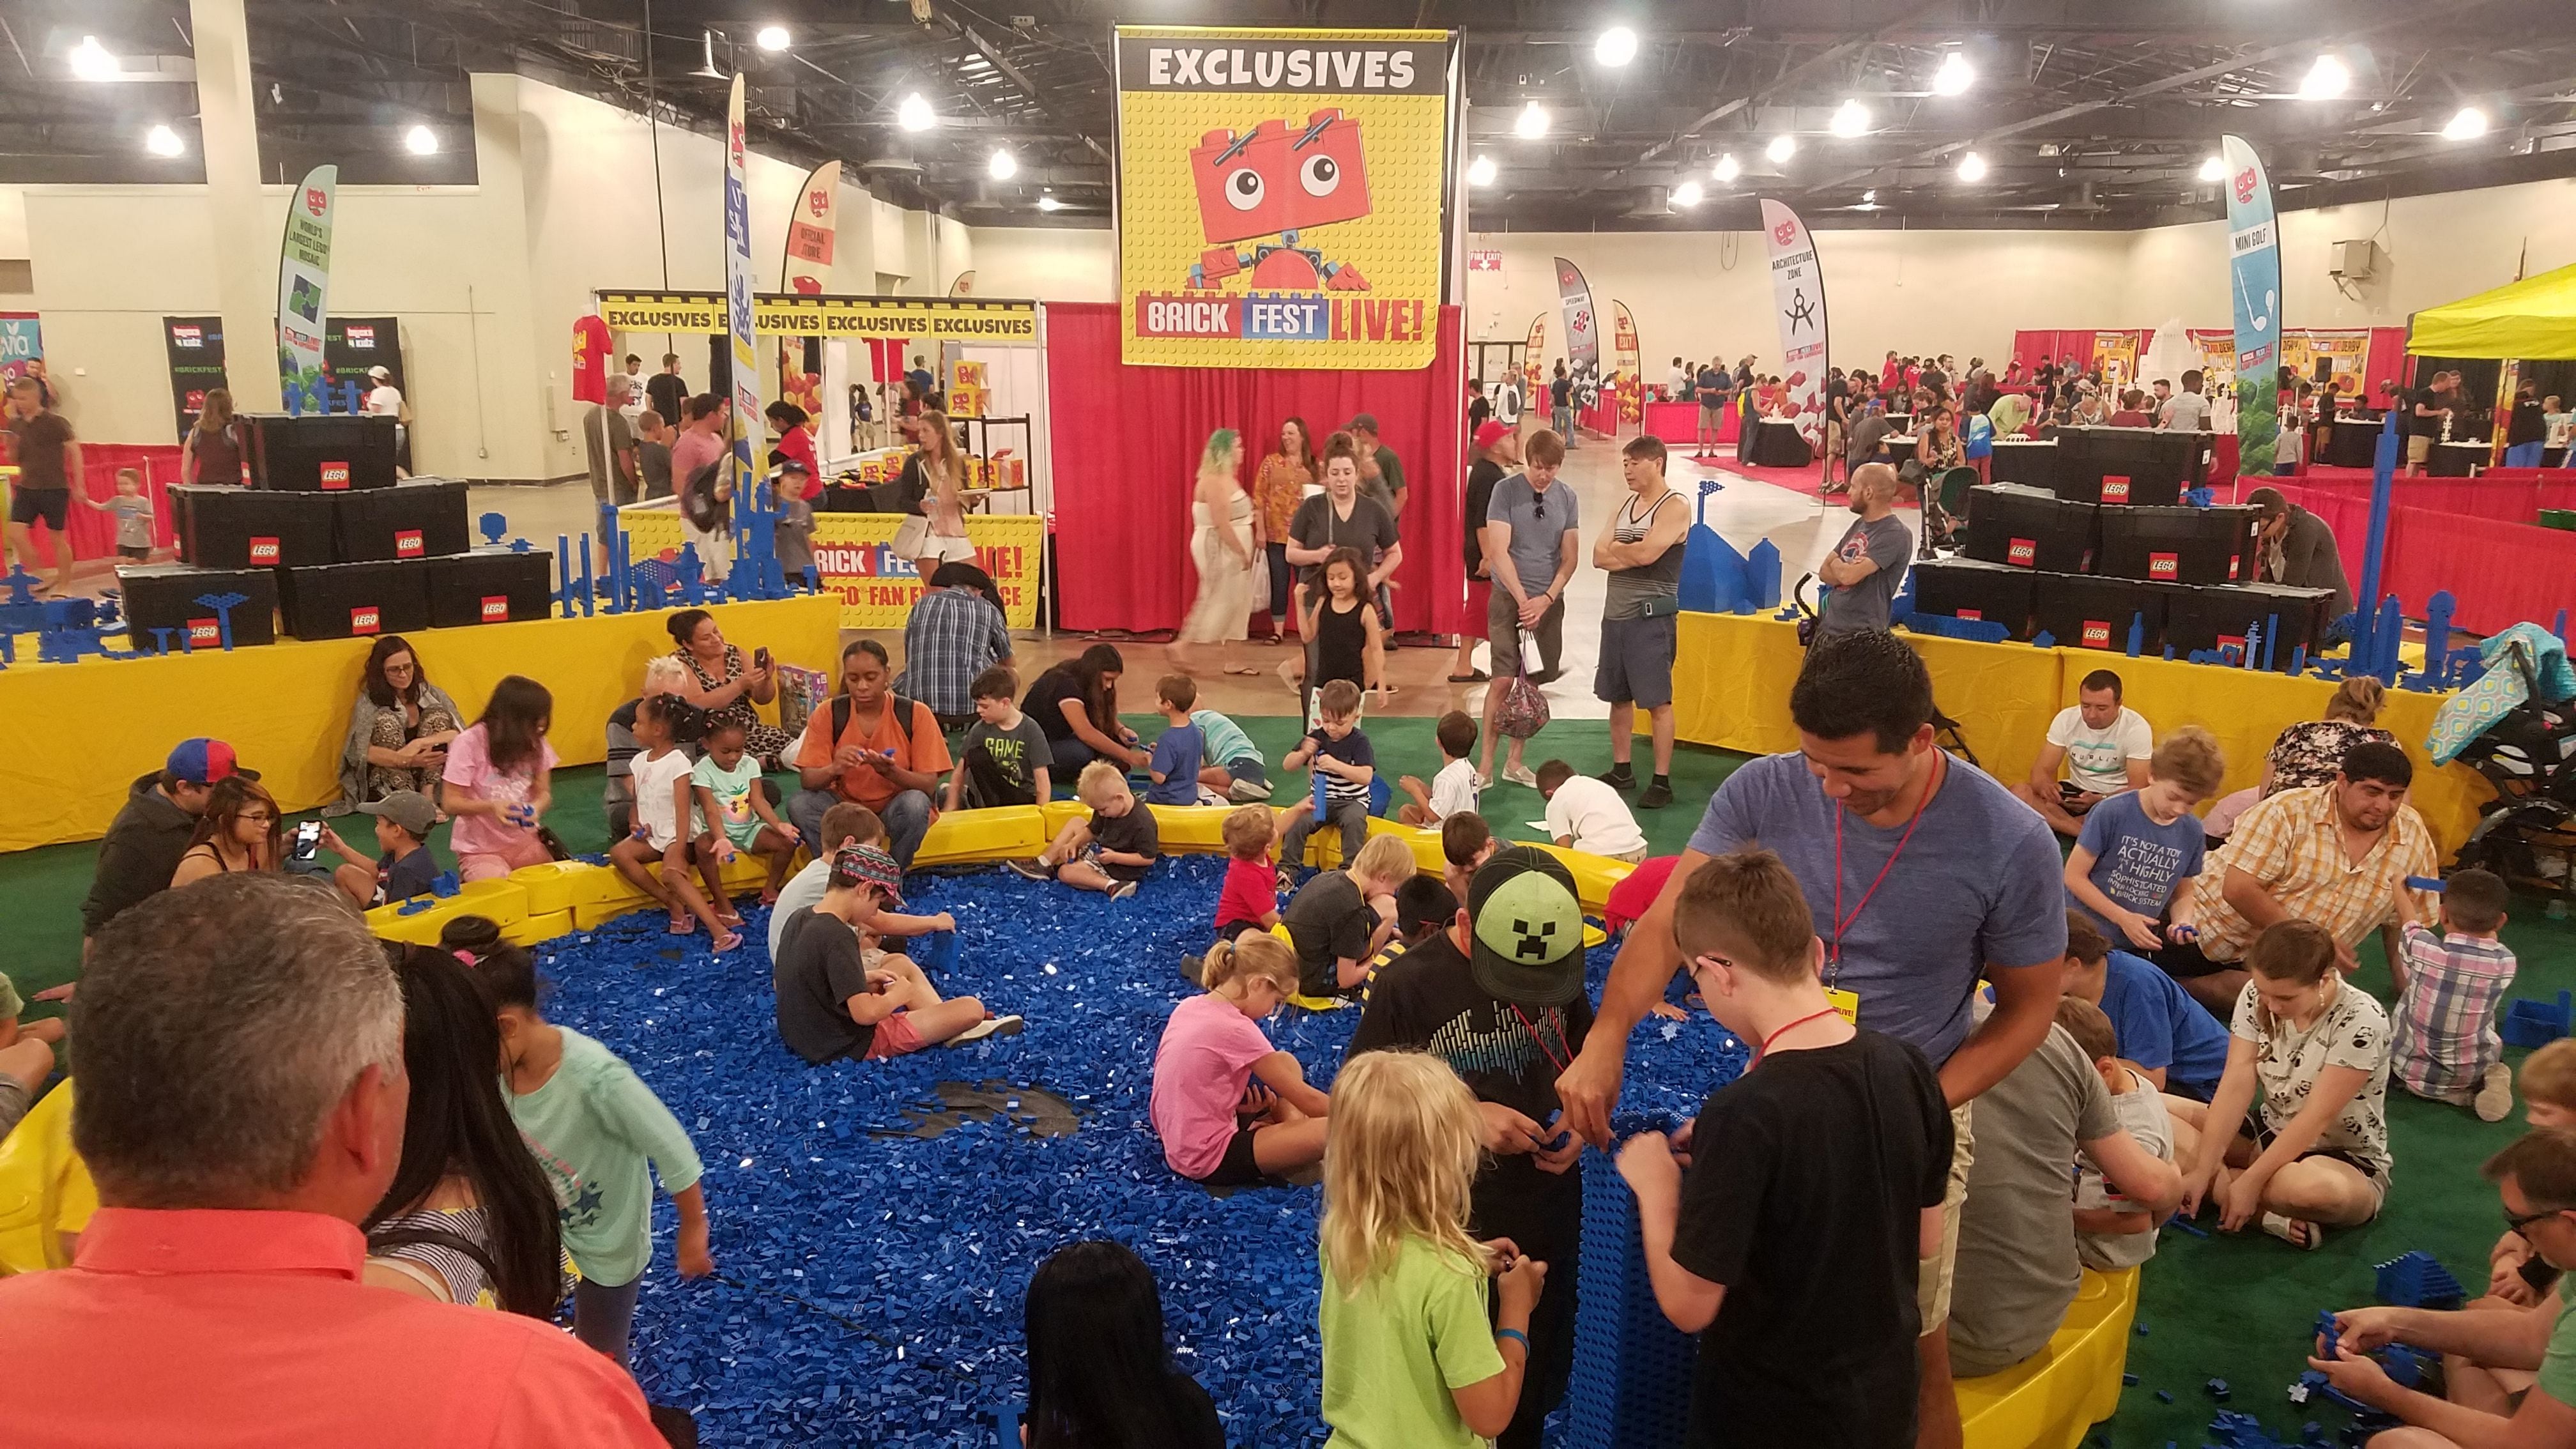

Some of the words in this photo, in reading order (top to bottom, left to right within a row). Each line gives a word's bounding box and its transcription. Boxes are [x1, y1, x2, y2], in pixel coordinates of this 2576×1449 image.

[1149, 48, 1415, 88] EXCLUSIVES
[801, 227, 825, 244] OFFICIAL
[2235, 233, 2251, 252] MINI
[2251, 227, 2266, 247] GOLF
[1470, 252, 1485, 261] FIRE
[1486, 252, 1501, 261] EXIT
[1772, 250, 1814, 271] ARCHITECTURE
[1787, 267, 1802, 280] ZONE
[1565, 295, 1585, 305] SPEEDWAY
[608, 310, 711, 327] EXCLUSIVES
[826, 316, 927, 332] EXCLUSIVES
[933, 318, 1032, 334] EXCLUSIVES
[1147, 301, 1229, 333] BRICK
[1252, 303, 1319, 334] FEST
[1331, 298, 1423, 341] LIVE!
[322, 470, 348, 481] LEGO
[2103, 483, 2128, 495] LEGO
[252, 544, 279, 556] LEGO
[397, 537, 422, 549] LEGO
[2010, 545, 2034, 558] LEGO
[813, 549, 865, 573] RICK
[2150, 560, 2176, 572] LEGO
[870, 586, 907, 606] FAN
[483, 603, 507, 615] LEGO
[353, 613, 378, 627] LEGO
[2085, 629, 2108, 641] LEGO
[985, 737, 1025, 759] GAME
[2121, 834, 2139, 847] IT'S
[2140, 839, 2158, 852] NOT
[2158, 846, 2165, 854] A
[2166, 847, 2182, 858] TOY
[2117, 845, 2180, 871] ACTUALLY
[2119, 857, 2129, 866] IT'S
[2117, 863, 2124, 872] A
[2129, 861, 2175, 882] HIGHLY
[2116, 890, 2138, 904] BRICK
[2138, 895, 2162, 907] SYSTEM
